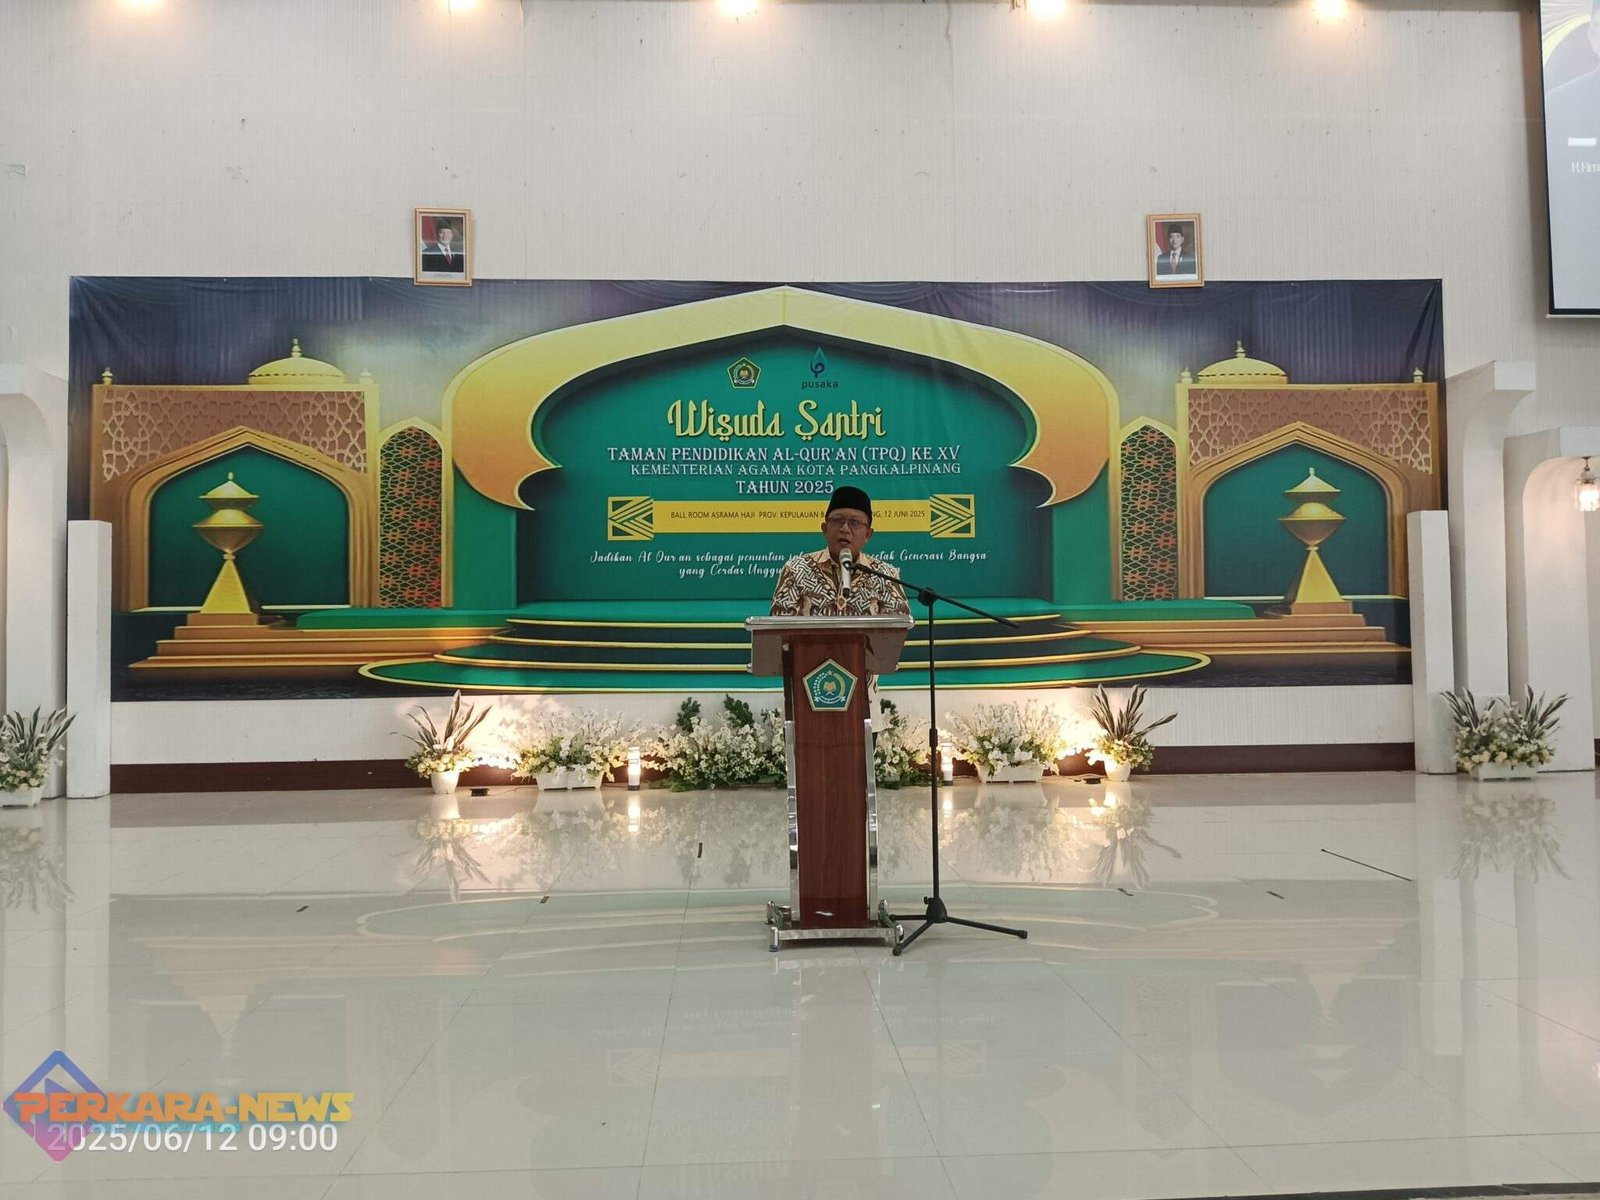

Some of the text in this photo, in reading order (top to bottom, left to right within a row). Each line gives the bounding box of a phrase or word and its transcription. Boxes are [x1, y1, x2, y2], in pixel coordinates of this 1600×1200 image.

[802, 380, 839, 389] pusaka
[667, 399, 887, 442] Wisuda Santri
[607, 445, 960, 462] TAMAN PENDIDIKAN AL-QUR'AN (TPQ) KE XV
[631, 463, 961, 475] KEMENTERIAN AGAMA KOTA PANGKALPINANG
[736, 480, 834, 494] TAHUN 2025
[670, 511, 686, 519] BALL
[688, 511, 709, 519] ROOM
[711, 511, 739, 519] ASRAMA
[741, 511, 755, 519] HAJI
[780, 511, 819, 519] KEPULAUAN
[893, 510, 908, 518] JUNI
[590, 550, 632, 563] Jadikan
[696, 551, 734, 565] sebagai
[737, 553, 785, 564] penuntun
[900, 549, 944, 560] Generasi
[949, 549, 987, 562] Bangsa
[679, 567, 705, 578] yang
